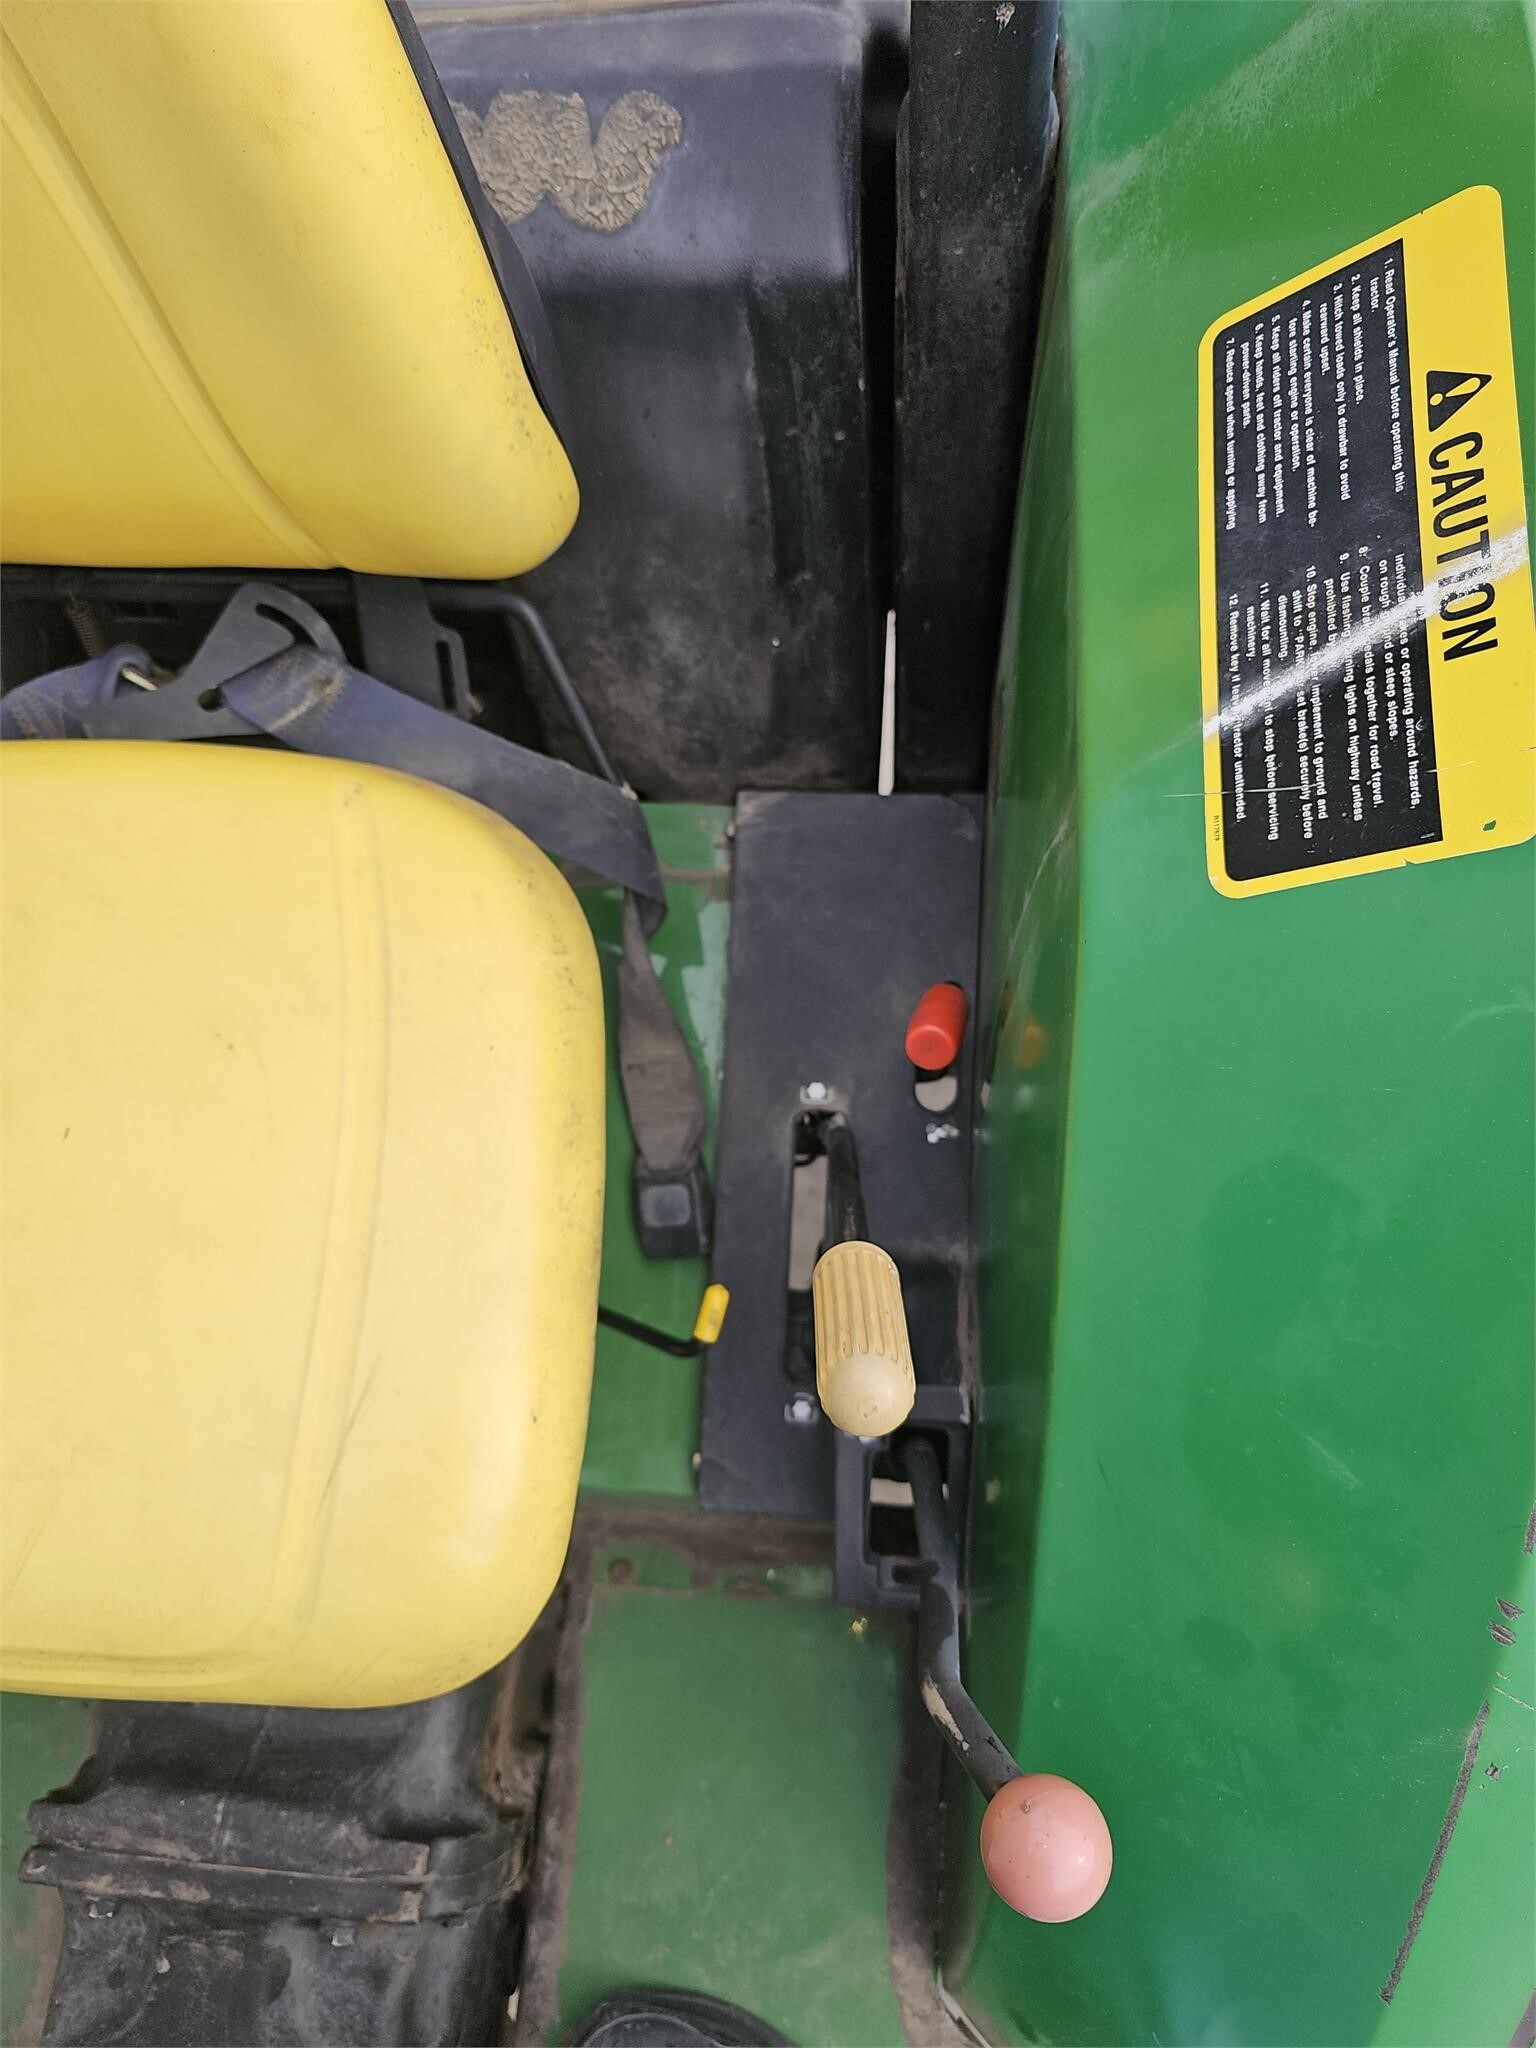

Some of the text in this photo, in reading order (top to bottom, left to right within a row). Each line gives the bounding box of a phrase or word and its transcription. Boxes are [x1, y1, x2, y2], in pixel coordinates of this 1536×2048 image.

[1302, 299, 1311, 310] 4.
[1369, 276, 1379, 312] tractor.
[1302, 309, 1311, 336] Make
[1318, 302, 1330, 375] rearward upset.
[1349, 273, 1364, 404] 2. Keep all shields in place.
[1302, 337, 1312, 370] certain
[1240, 341, 1251, 428] power-driven parts.
[1302, 371, 1312, 414] everyone
[1333, 282, 1351, 500] 3. Hitch towed loads only to drawbar to avoid
[1383, 257, 1405, 492] 1. Read Operator's Manual before operating this
[1287, 317, 1301, 471] fore starting engine or operation.
[1224, 337, 1236, 530] 7. Reduce speed when turning or applying
[1253, 322, 1267, 523] 6. Keep hands, feet and clothing away from
[1269, 314, 1284, 517] 5. Keep all riders off tractor and equipment.
[1304, 415, 1314, 426] is
[1305, 427, 1315, 451] clear
[1306, 454, 1316, 465] of
[1306, 466, 1317, 508] machine
[1429, 432, 1498, 661] CAUTION
[1259, 582, 1269, 598] 11.
[1306, 565, 1316, 581] 10.
[1358, 565, 1370, 602] Couple
[1260, 599, 1270, 623] Wait
[1292, 589, 1303, 613] shift
[1305, 583, 1317, 608] Stop
[1323, 577, 1337, 631] prohibited
[1245, 605, 1256, 661] machinery.
[1261, 625, 1271, 640] for
[1277, 594, 1289, 660] dismounting.
[1293, 615, 1302, 626] to
[1306, 611, 1318, 650] engine,
[1360, 604, 1373, 635] brak
[1261, 643, 1271, 656] all
[1325, 632, 1338, 647] by
[1378, 559, 1398, 740] on rough gund or steep slopes.
[1296, 690, 1306, 707] set
[1339, 552, 1363, 821] 9. Use flashing ning lights on highway unless
[1363, 675, 1378, 721] together
[1394, 553, 1421, 808] individual akes or operating around hazards,
[1228, 593, 1246, 822] 12. Remove key if leavng tractor unattended.
[1264, 713, 1273, 725] to
[1309, 683, 1323, 739] implement
[1263, 728, 1274, 751] stop
[1296, 708, 1309, 752] brake(s)
[1314, 741, 1324, 753] to
[1368, 724, 1379, 740] for
[1264, 753, 1277, 788] before
[1369, 744, 1381, 769] road
[1297, 754, 1311, 799] securely
[1312, 756, 1327, 795] ground
[1371, 771, 1384, 807] travel.
[1267, 791, 1279, 840] servicing
[1302, 802, 1313, 838] before
[1316, 798, 1328, 819] and
